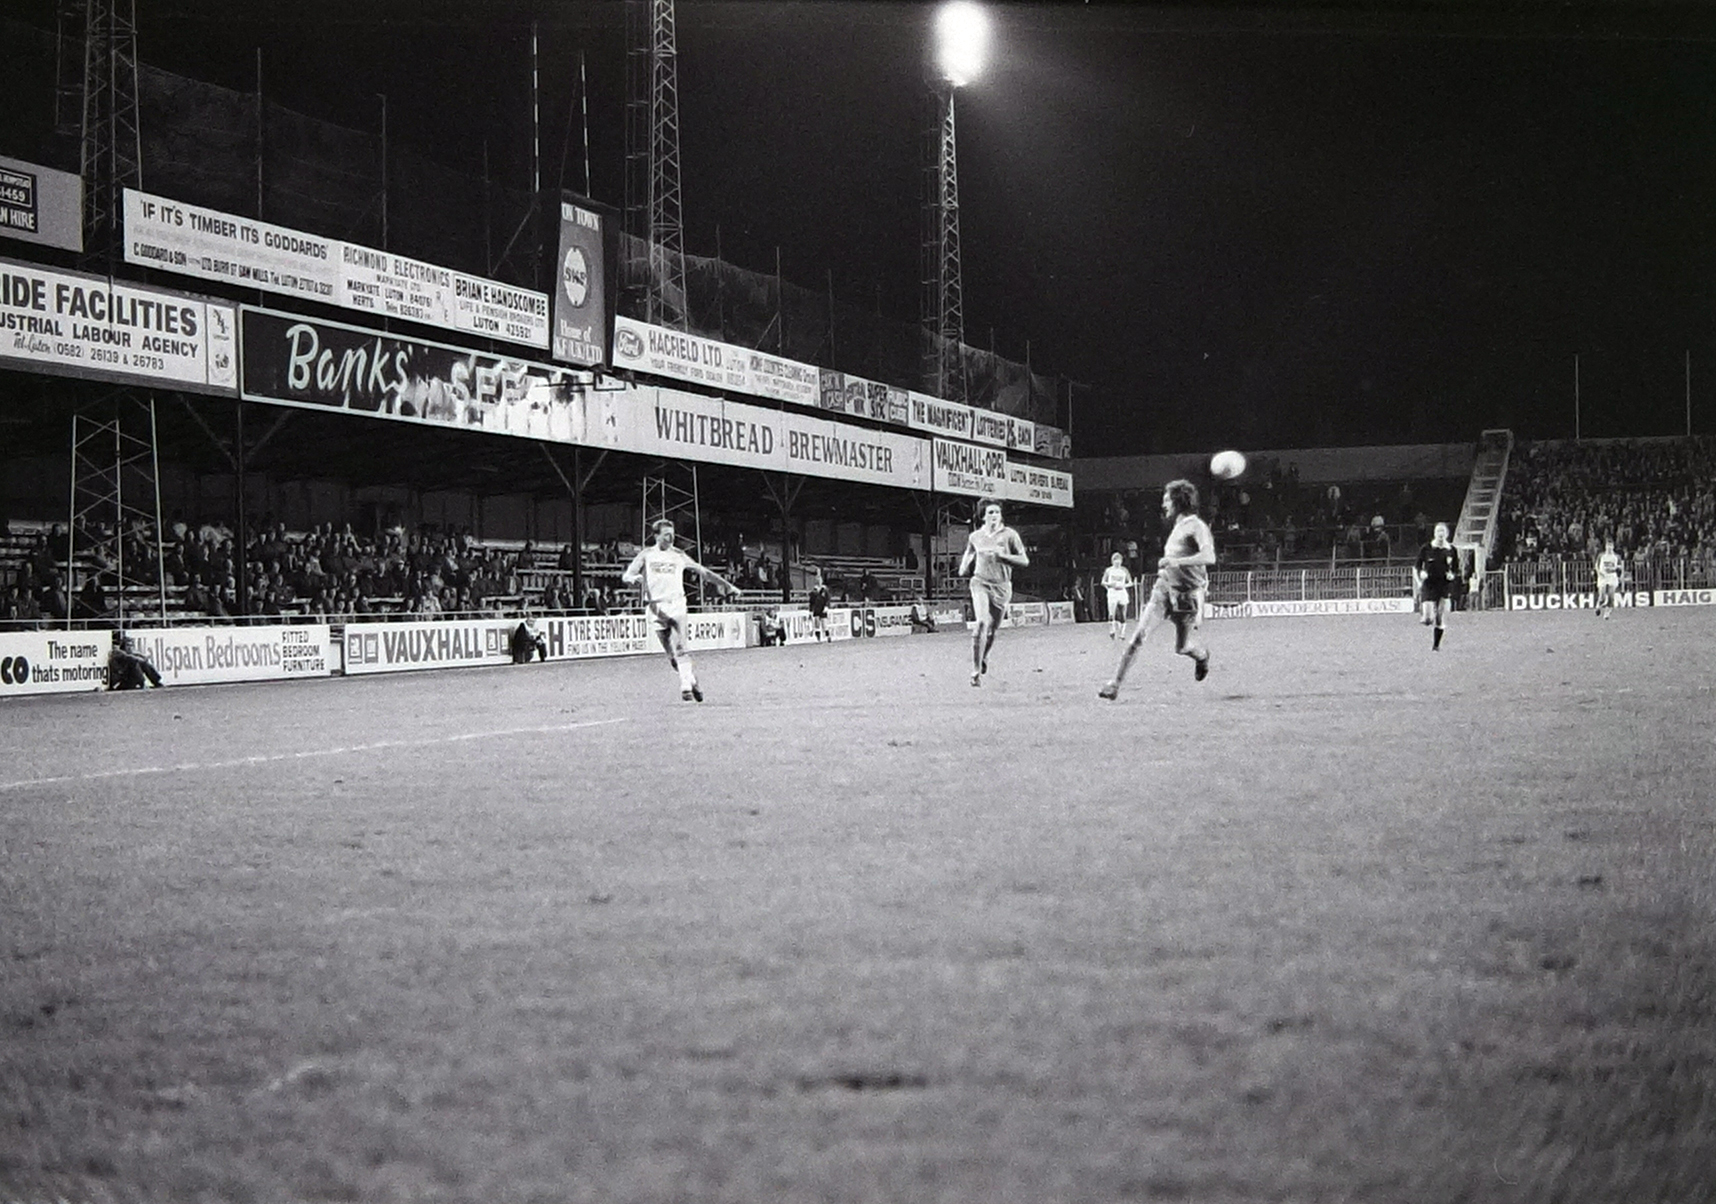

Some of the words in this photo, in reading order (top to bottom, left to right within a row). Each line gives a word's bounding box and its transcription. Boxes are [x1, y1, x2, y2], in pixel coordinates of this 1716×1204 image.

[10, 209, 35, 230] HIRE
[189, 213, 237, 239] TIMBER
[343, 246, 387, 272] RICHMOND
[394, 259, 450, 288] ELECTRONICS
[456, 278, 482, 301] BRIAN
[483, 285, 490, 303] E
[491, 287, 546, 317] HANDSCOMBE
[56, 282, 198, 337] FACILITIES
[473, 315, 500, 332] LUTON
[73, 323, 132, 348] LABOUR
[142, 335, 199, 358] AGENCY
[870, 400, 886, 420] SIX
[912, 399, 925, 424] THE
[655, 406, 774, 455] WHITBREAD
[789, 430, 893, 473] BREWMASTER
[1512, 591, 1650, 611] DUCKHMS
[1662, 590, 1713, 606] HAIG
[282, 630, 309, 643] FITTED
[567, 620, 592, 640] TYRE
[594, 618, 631, 640] SERVICE
[632, 618, 647, 638] LTD
[694, 622, 726, 639] ARROW
[47, 640, 68, 659] The
[70, 644, 98, 659] name
[205, 635, 281, 670] Bedrooms
[282, 644, 320, 658] BEDROOM
[383, 628, 484, 664] VAUXHALL
[32, 664, 60, 683] thats
[62, 663, 109, 685] motoring
[282, 659, 325, 672] FURNITURE
